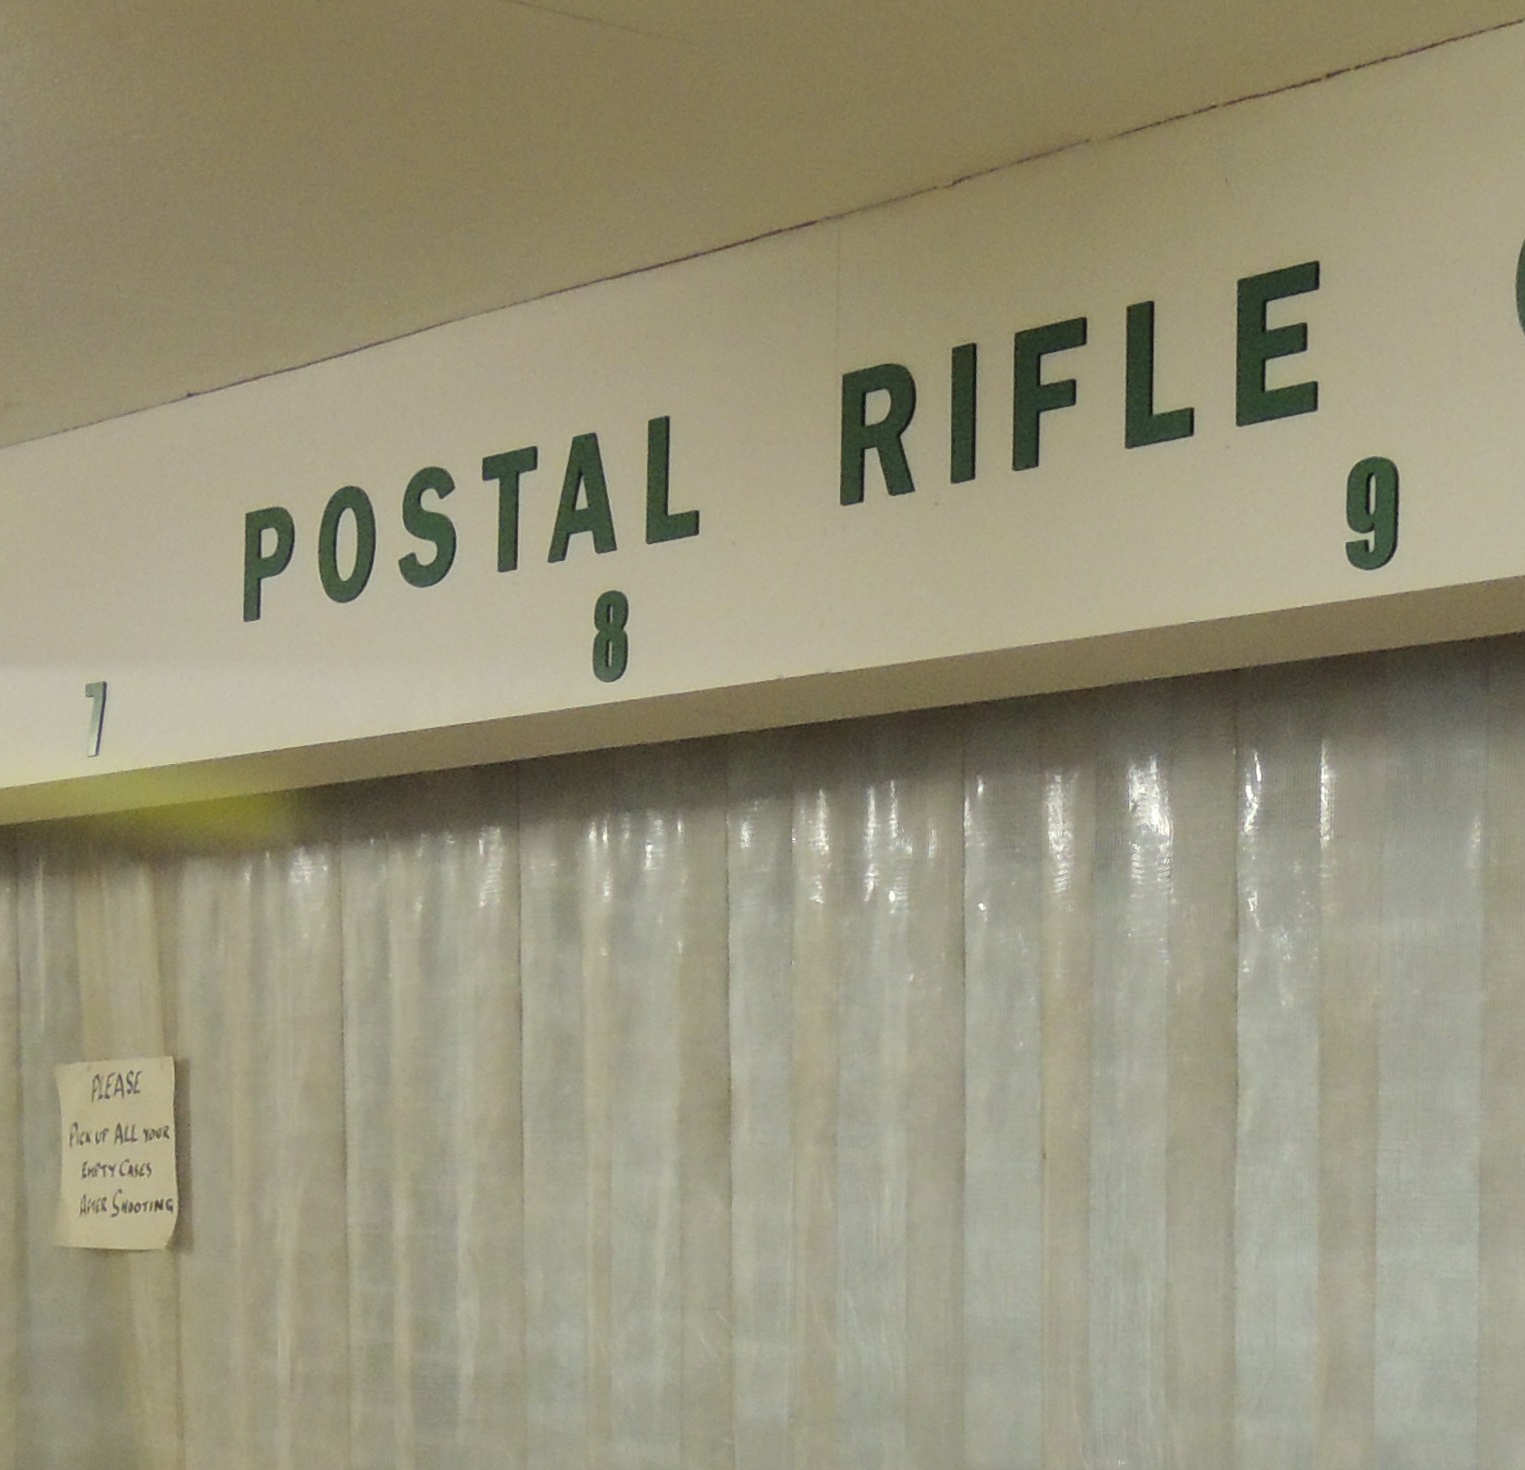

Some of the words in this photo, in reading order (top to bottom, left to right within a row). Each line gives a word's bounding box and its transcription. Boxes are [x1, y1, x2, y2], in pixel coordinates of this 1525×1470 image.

[242, 416, 701, 622] POSTAL
[840, 260, 1321, 506] RIFLE
[1345, 456, 1400, 571] 9
[592, 590, 630, 683] 8
[85, 681, 108, 758] 7
[90, 1070, 142, 1104] PLEASE
[114, 1122, 139, 1145] ALL
